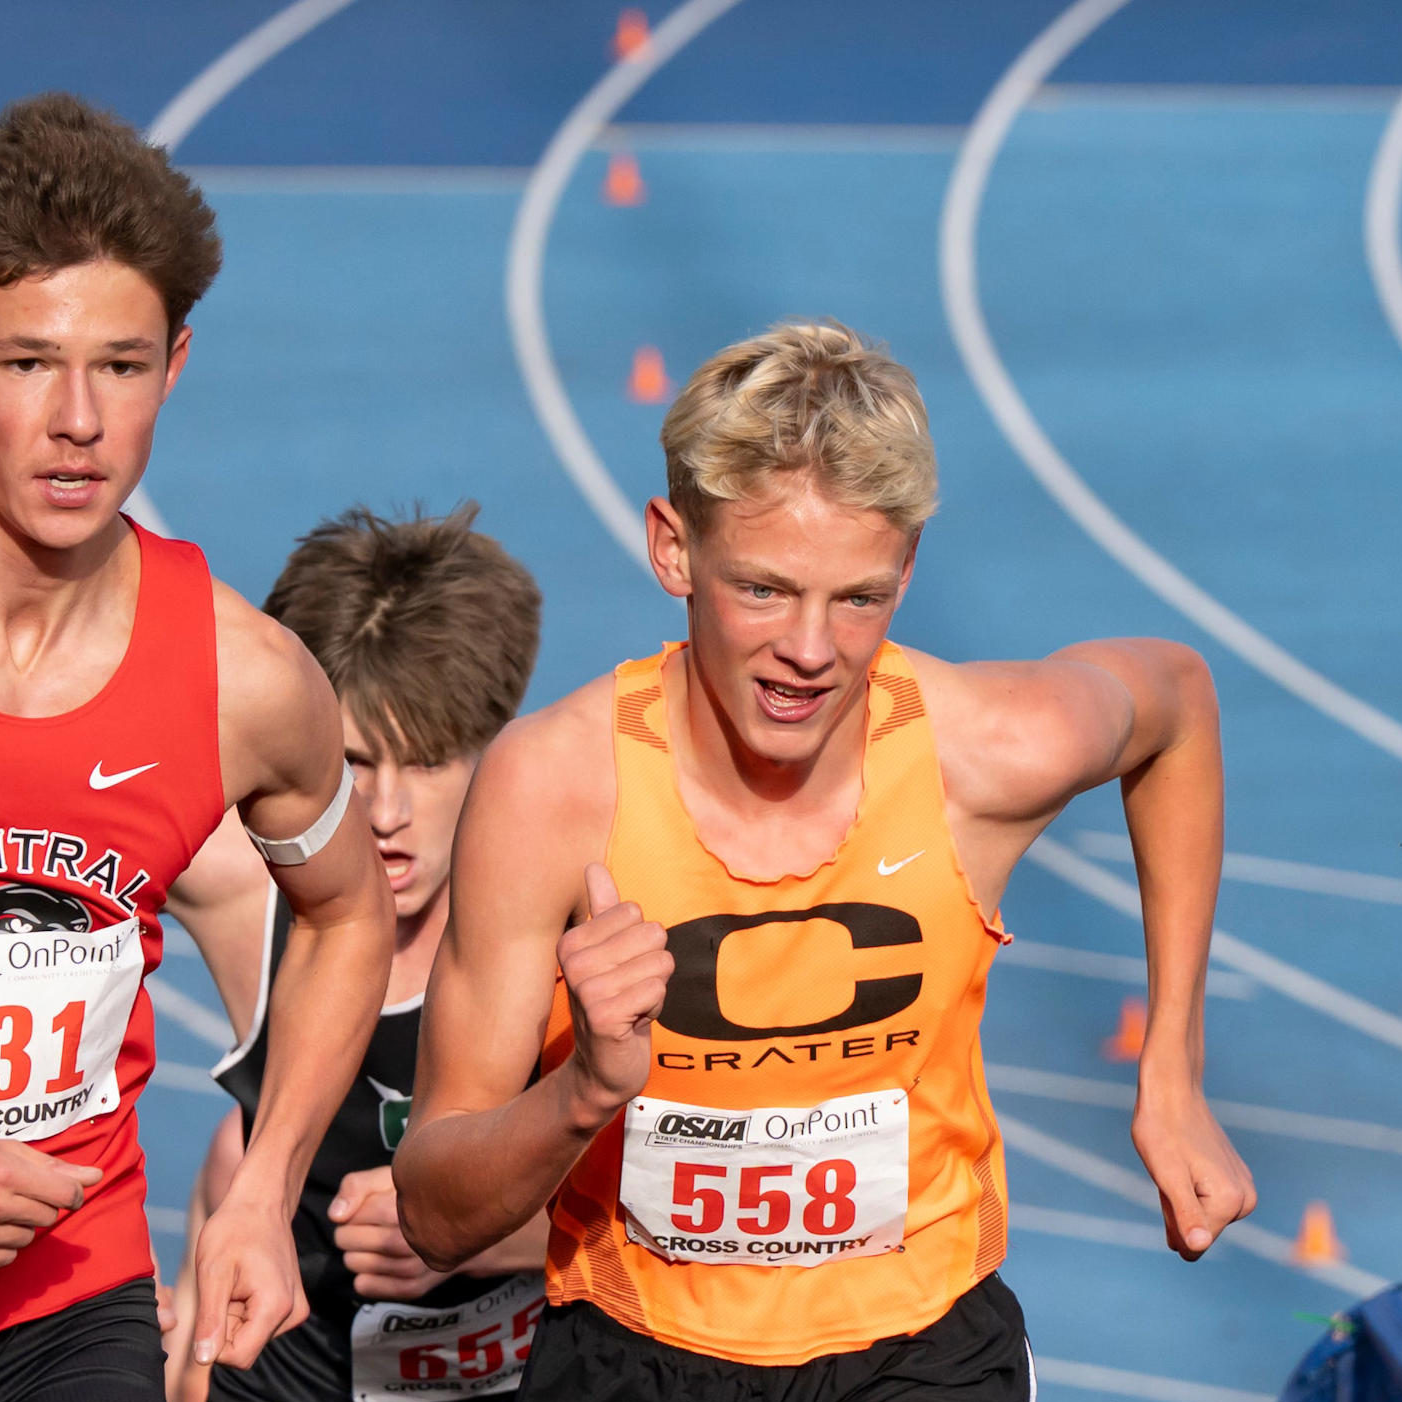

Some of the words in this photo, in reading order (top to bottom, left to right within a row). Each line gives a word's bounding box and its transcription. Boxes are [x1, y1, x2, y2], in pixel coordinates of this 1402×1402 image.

[8, 934, 122, 970] OnPoint
[654, 902, 924, 1041] C
[657, 1029, 921, 1072] CRATER
[657, 1113, 748, 1142] OSAA
[765, 1102, 879, 1139] OnPoint
[655, 1134, 678, 1143] STATE
[678, 1138, 743, 1150] CHAMPIONSHIPS
[670, 1158, 858, 1236] 558
[653, 1236, 739, 1253] CROSS
[746, 1235, 874, 1255] COUNTRY
[382, 1312, 460, 1333] OSAA
[399, 1294, 547, 1380] 655
[384, 1381, 463, 1393] CROSS
